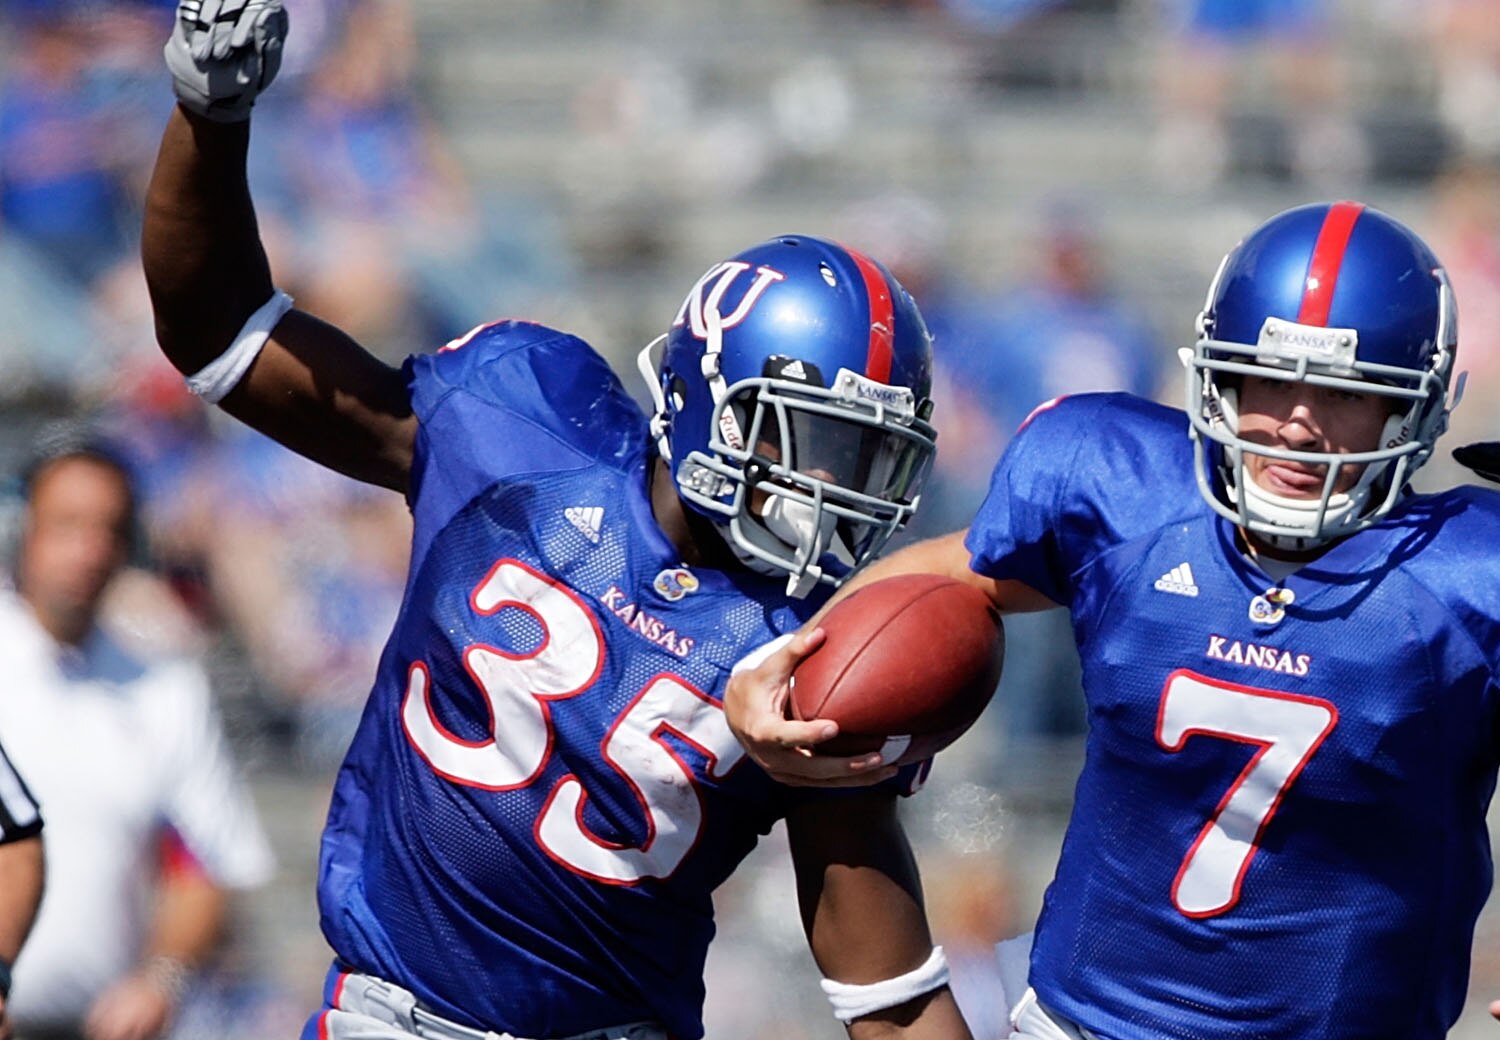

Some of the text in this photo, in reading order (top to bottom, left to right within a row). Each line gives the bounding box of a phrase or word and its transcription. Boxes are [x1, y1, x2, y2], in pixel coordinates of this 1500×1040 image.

[672, 260, 785, 339] KU
[600, 583, 695, 658] KANSAS
[1205, 634, 1312, 677] KANSAS
[401, 557, 746, 886] 35
[1155, 668, 1339, 920] 7
